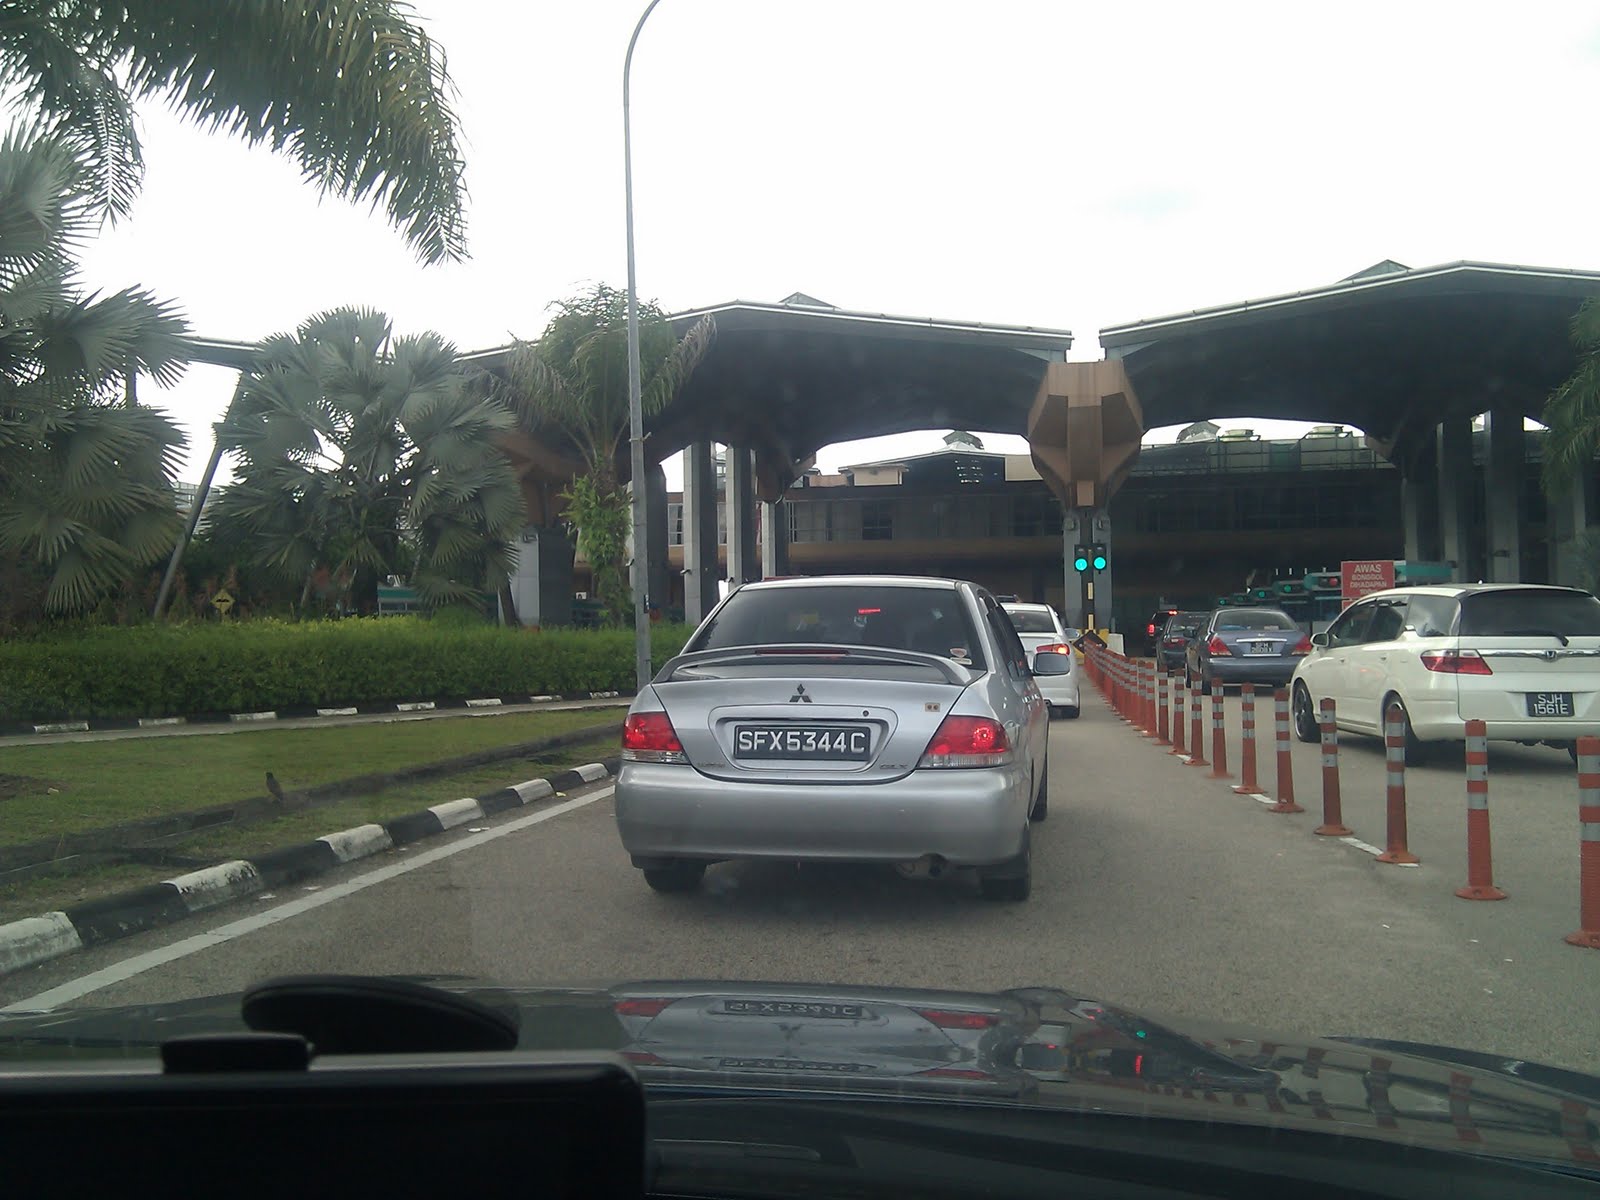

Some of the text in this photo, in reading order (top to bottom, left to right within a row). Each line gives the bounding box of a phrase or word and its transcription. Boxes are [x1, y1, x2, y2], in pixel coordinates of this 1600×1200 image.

[1354, 564, 1382, 573] AWAS
[1537, 694, 1563, 704] SJH
[1534, 703, 1569, 714] 1561E
[738, 731, 866, 753] SFX5344C
